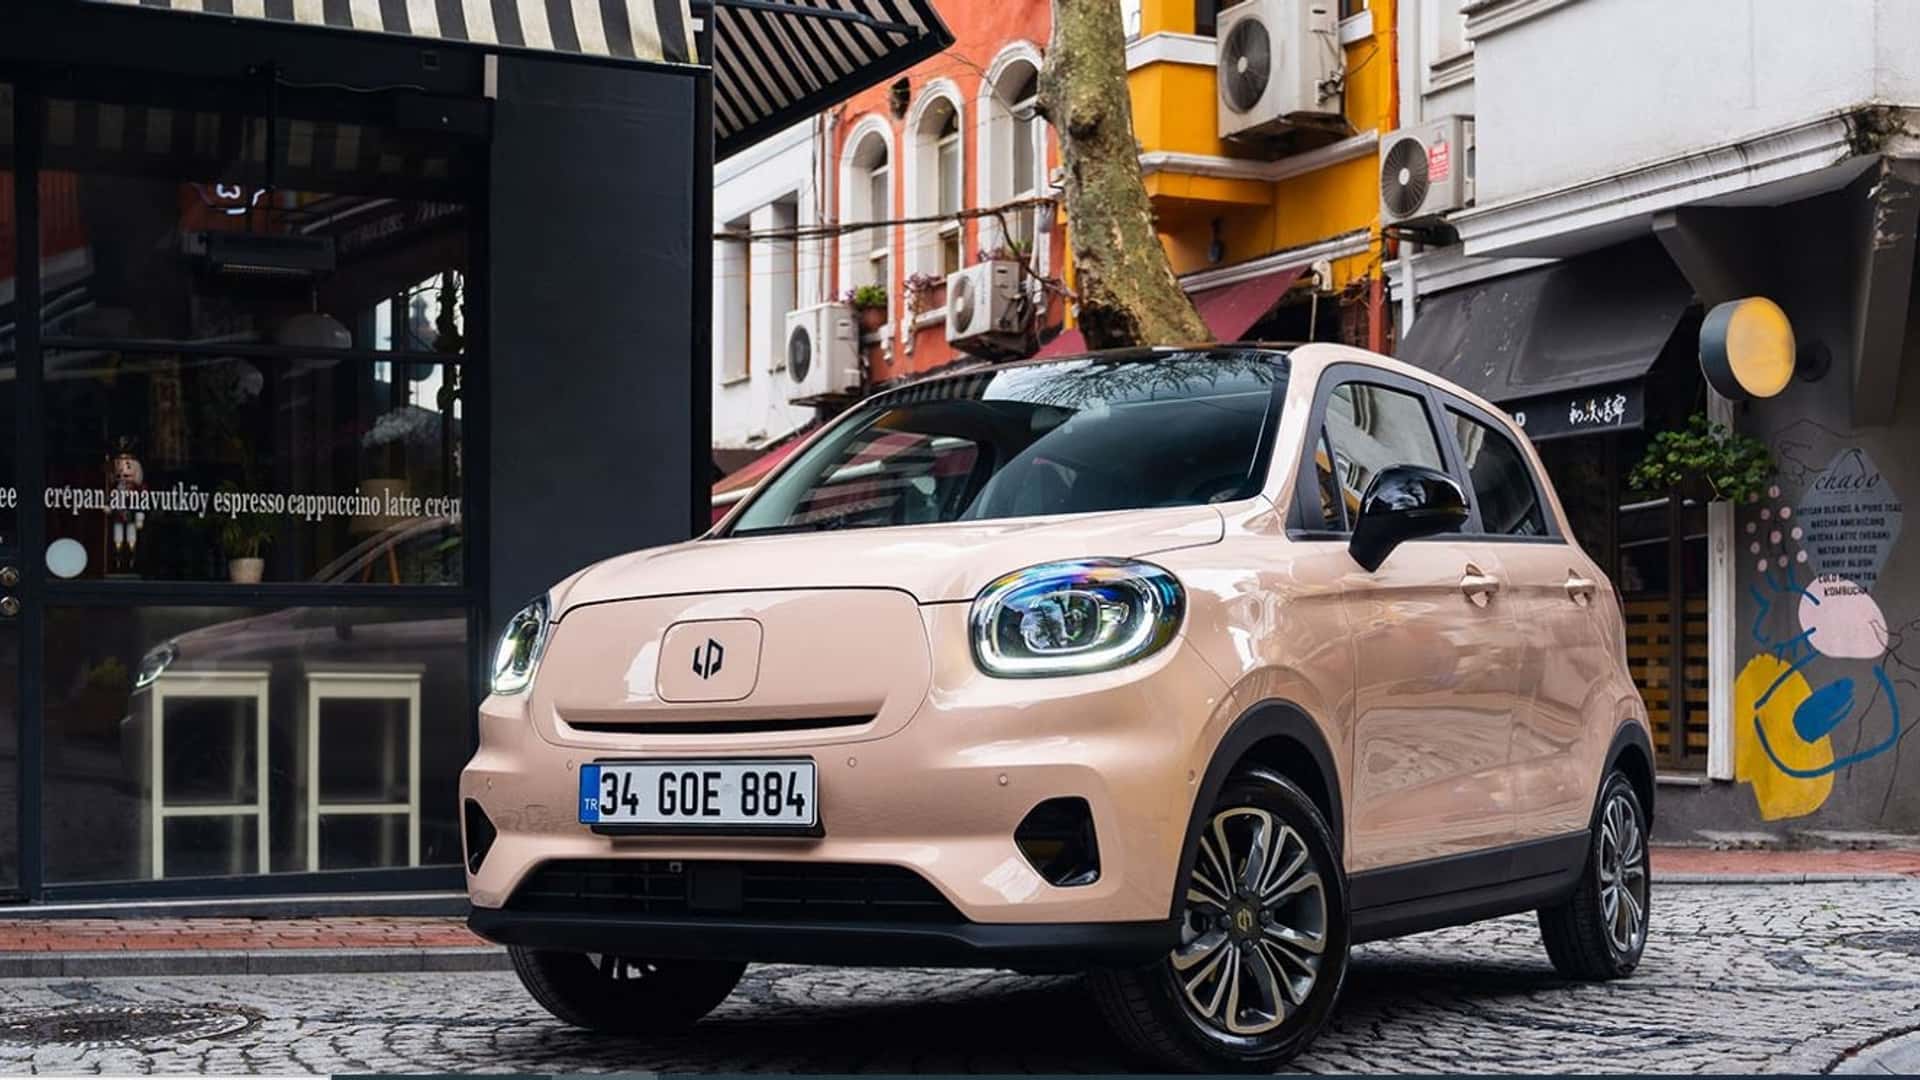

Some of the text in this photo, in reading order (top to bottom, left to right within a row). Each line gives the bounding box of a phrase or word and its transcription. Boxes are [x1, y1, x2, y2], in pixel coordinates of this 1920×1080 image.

[109, 481, 208, 518] arnavutköy
[213, 491, 285, 519] espresso
[287, 488, 381, 521] cappuccino
[384, 488, 421, 516] latte
[1811, 517, 1885, 528] MATCHA AMERICANO
[1808, 532, 1834, 542] MATCHA
[1836, 532, 1857, 541] LATTE
[1818, 546, 1845, 555] MATCHA
[1818, 573, 1836, 583] COLD
[1864, 572, 1877, 580] TEA
[584, 771, 805, 817] TR 34 GOE 884
